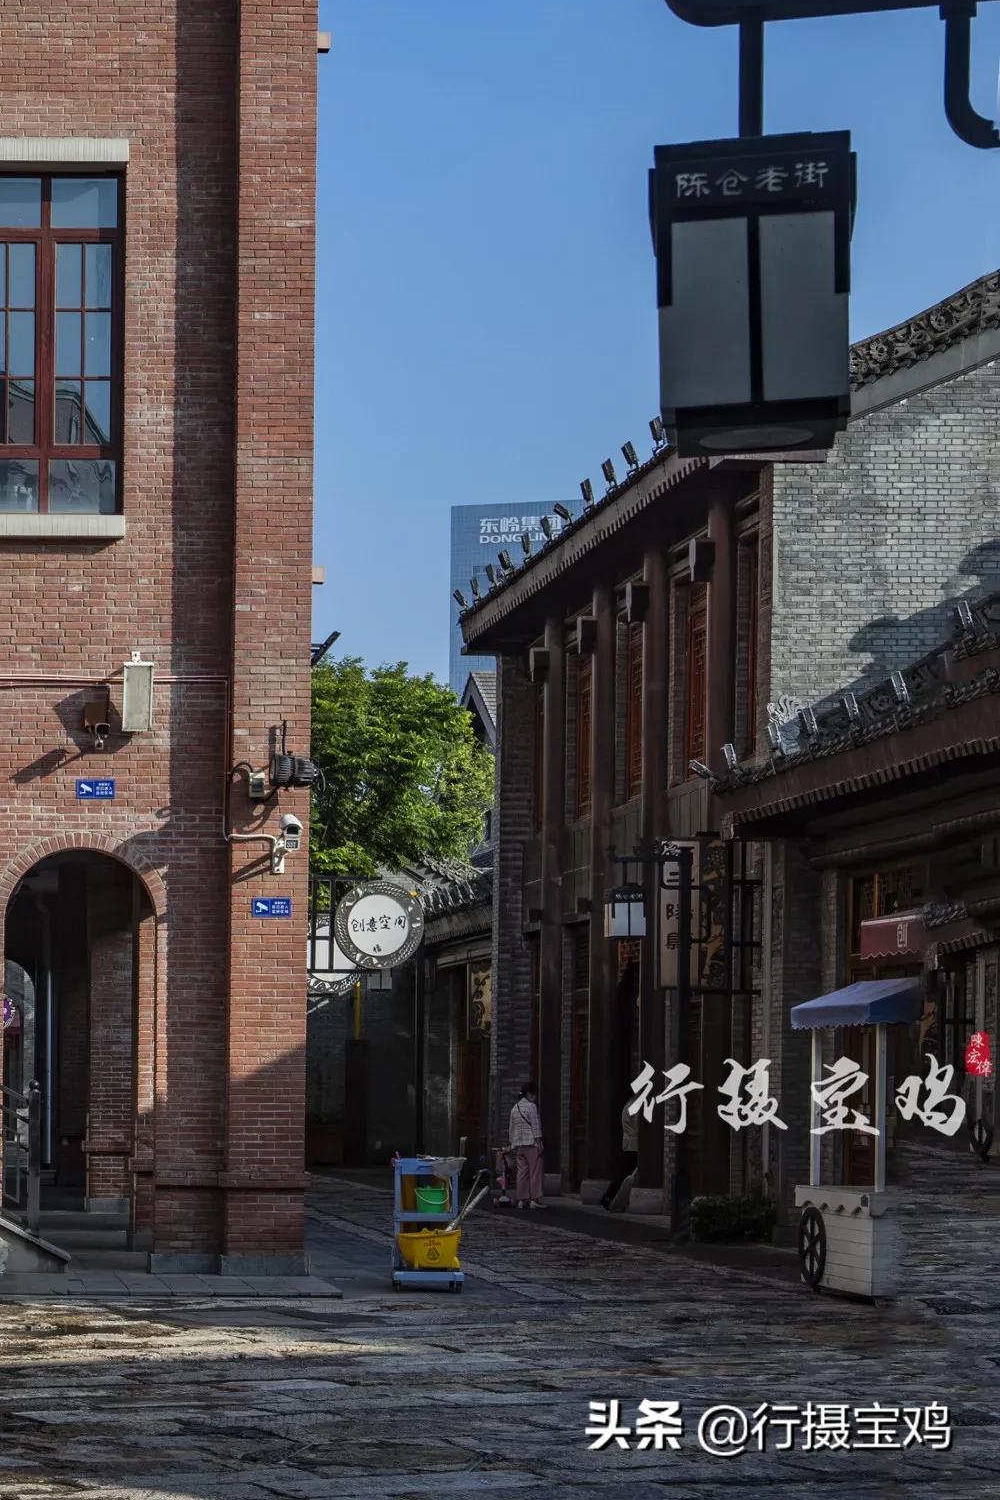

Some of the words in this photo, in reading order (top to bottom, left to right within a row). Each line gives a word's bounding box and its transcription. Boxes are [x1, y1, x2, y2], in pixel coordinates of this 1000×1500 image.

[675, 161, 829, 198] 陈仓老街
[479, 515, 561, 534] 东岭集团
[479, 533, 522, 544] DONG
[351, 915, 407, 933] 创意空间
